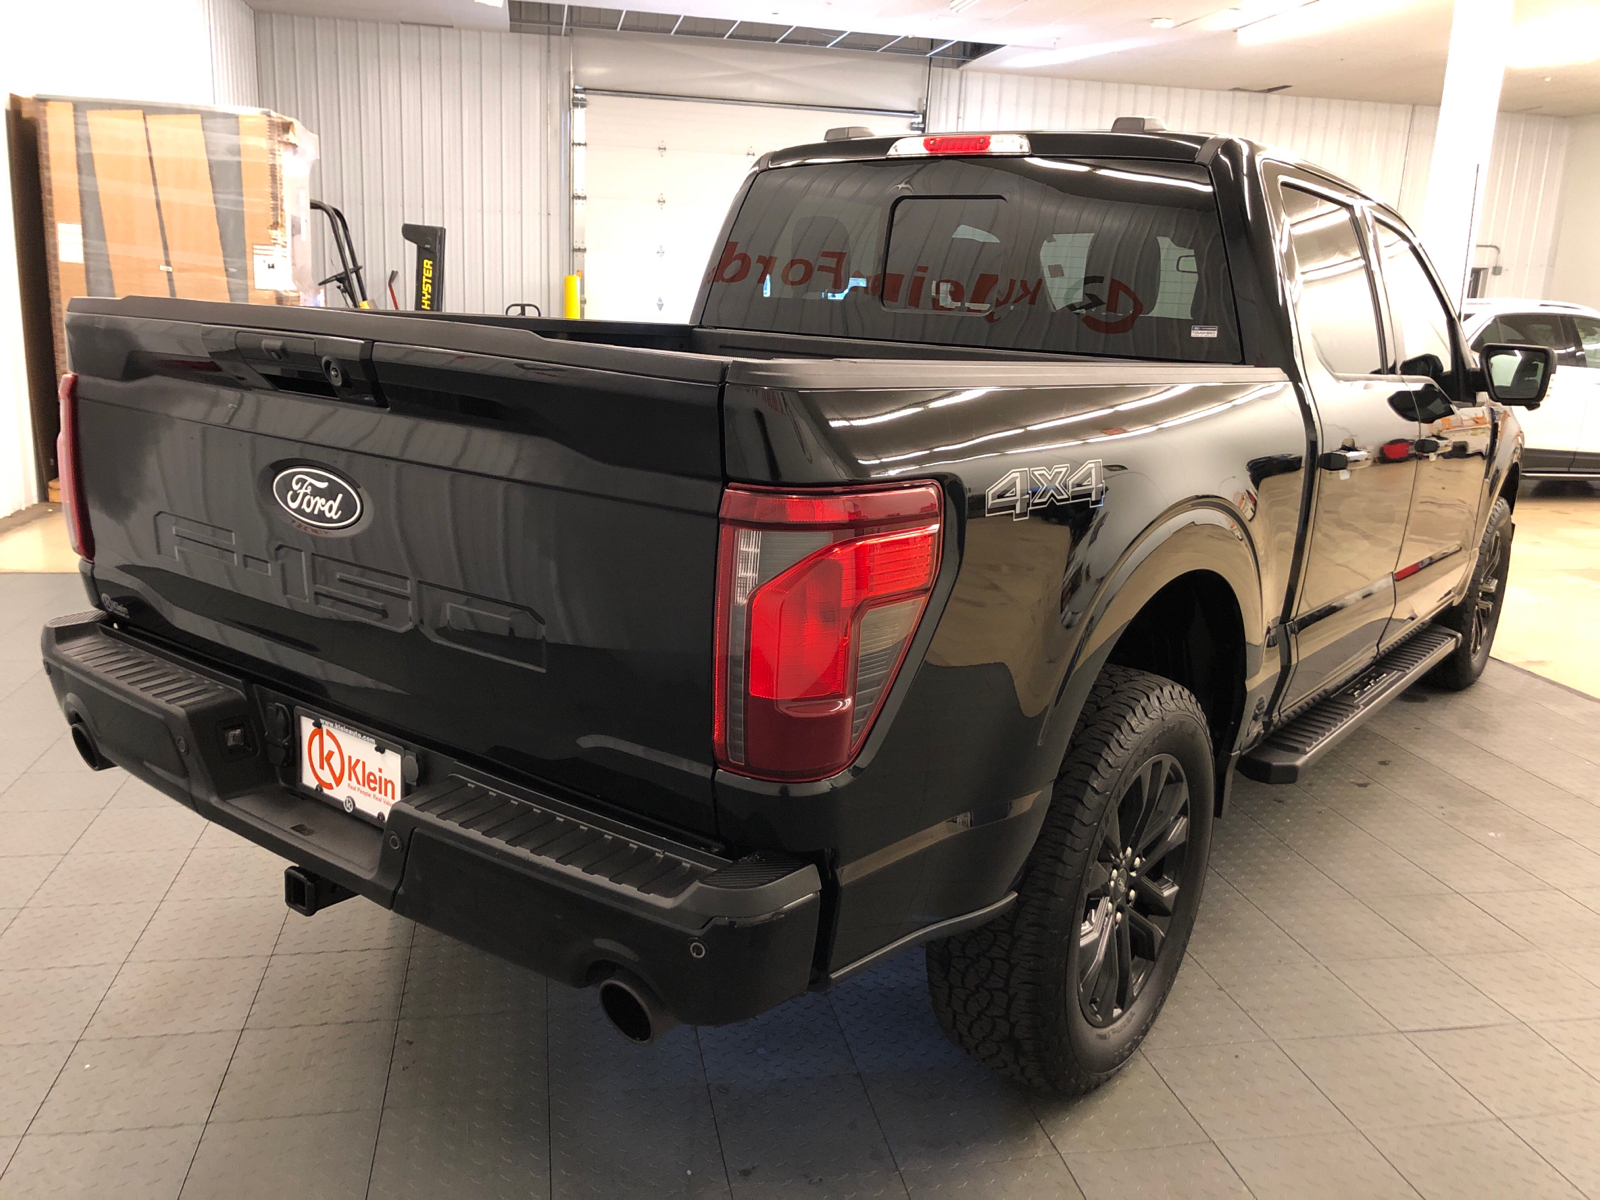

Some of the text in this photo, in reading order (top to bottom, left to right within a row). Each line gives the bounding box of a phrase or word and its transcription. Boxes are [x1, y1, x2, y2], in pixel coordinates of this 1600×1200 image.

[421, 259, 433, 310] HYSTER
[287, 474, 343, 520] Ford
[154, 511, 546, 673] F-150
[348, 755, 395, 801] Klein
